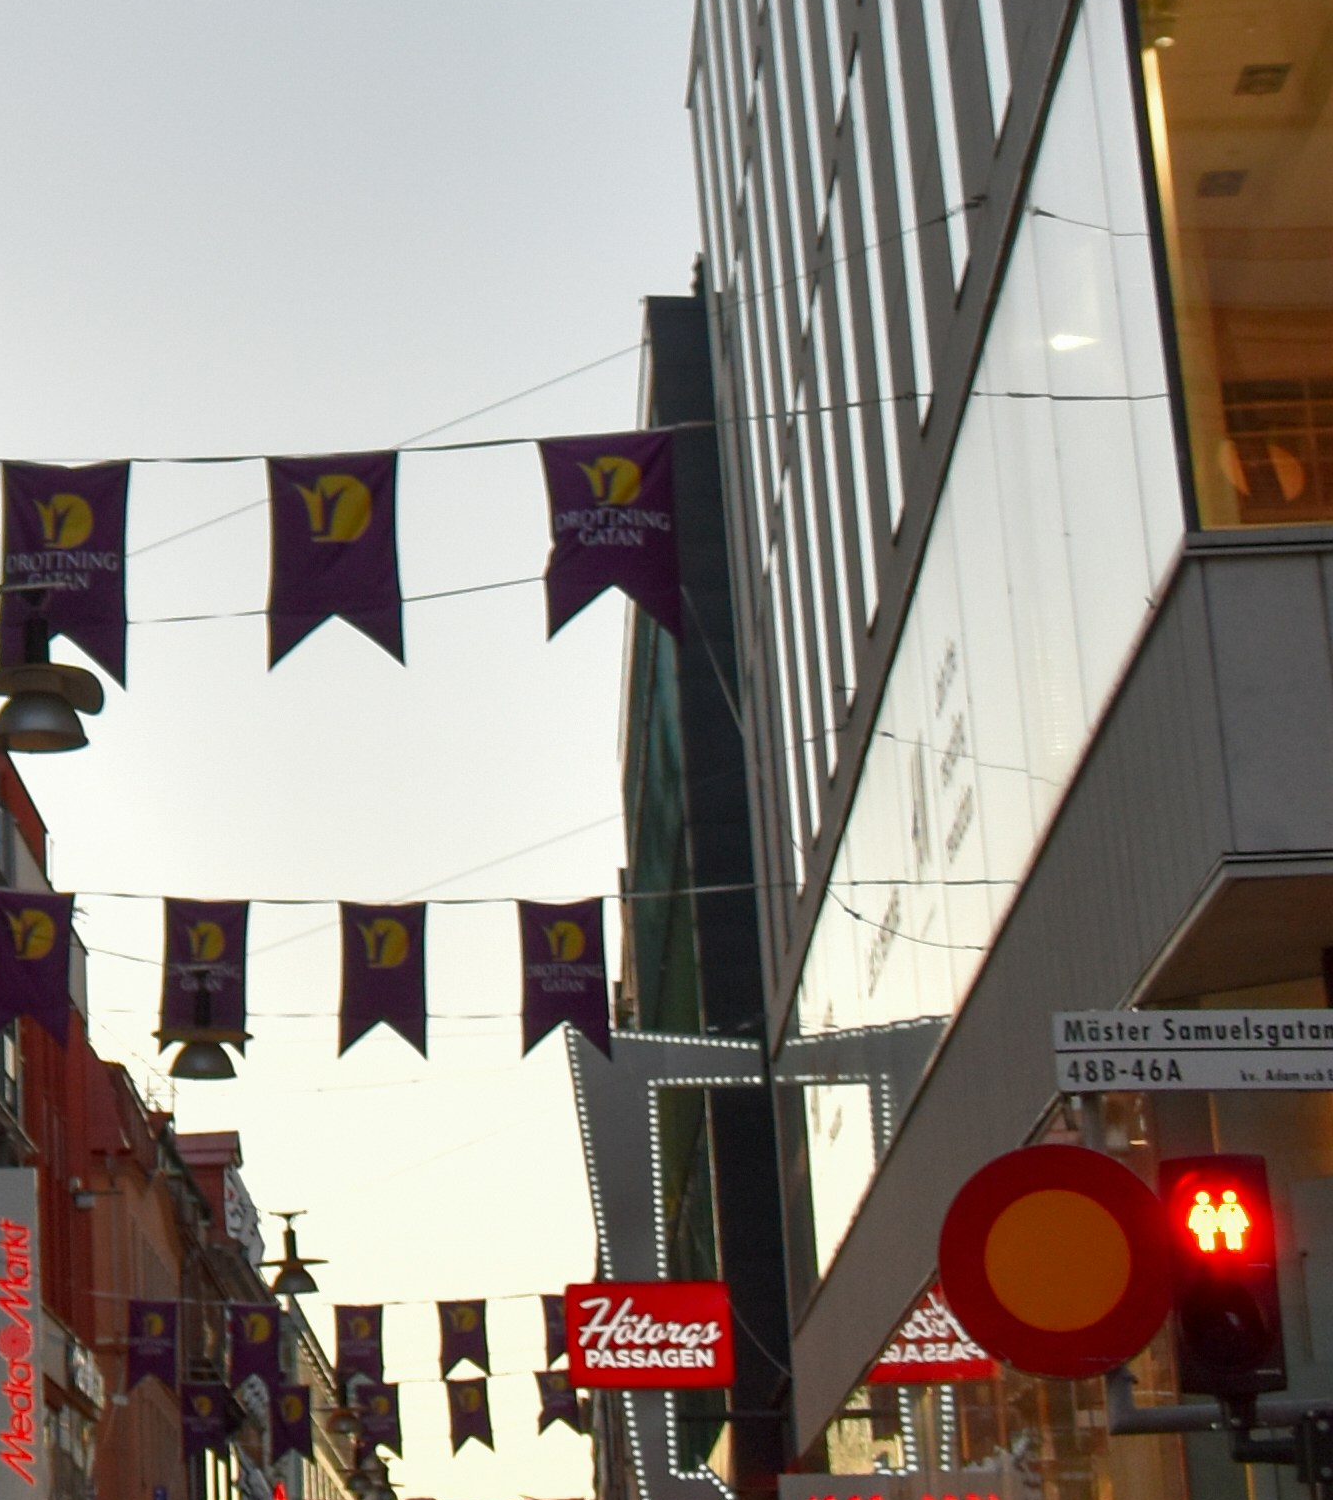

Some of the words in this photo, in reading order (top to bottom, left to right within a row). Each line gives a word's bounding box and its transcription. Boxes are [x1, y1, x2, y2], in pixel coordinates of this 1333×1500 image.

[553, 507, 672, 532] DROTTNING
[577, 528, 644, 546] GATAN
[5, 550, 119, 571] DROTTNING
[1064, 1019, 1151, 1043] Mäster
[1163, 1016, 1333, 1046] Samuelsgatan
[1066, 1058, 1183, 1082] 48B-46A
[1265, 1069, 1301, 1082] Adam
[578, 1296, 723, 1349] Hötorgs
[585, 1347, 715, 1369] PASSAGEN
